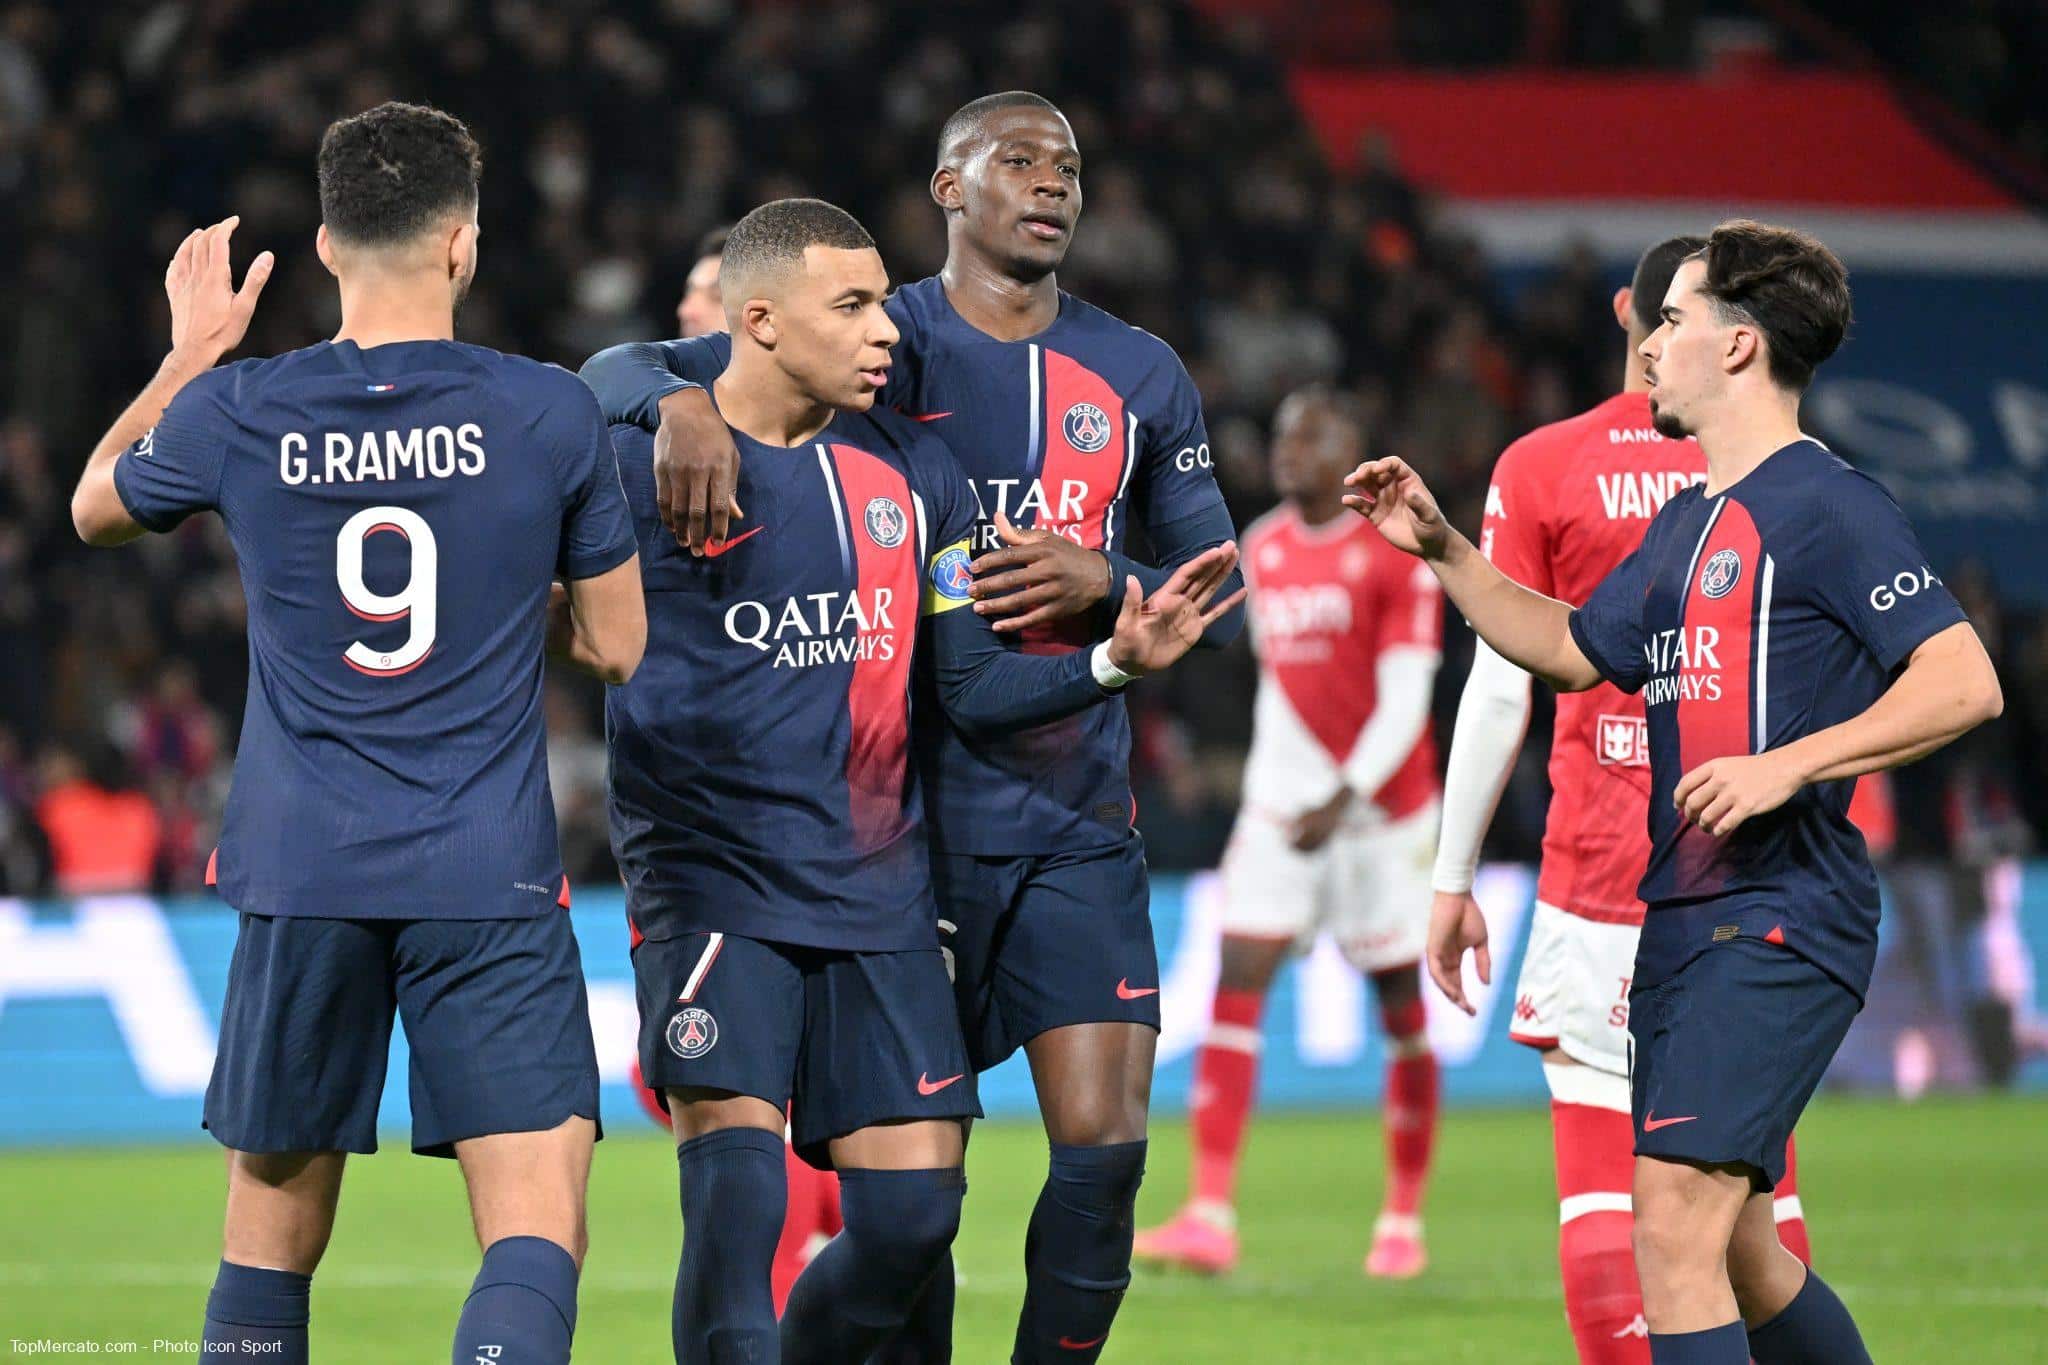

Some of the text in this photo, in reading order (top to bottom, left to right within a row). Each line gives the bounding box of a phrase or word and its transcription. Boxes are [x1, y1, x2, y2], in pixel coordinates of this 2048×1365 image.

[280, 423, 486, 485] G.RAMOS
[1175, 443, 1214, 472] GO
[1597, 472, 1707, 519] VAND
[336, 505, 438, 677] 9
[724, 587, 894, 651] QATAR
[772, 634, 894, 669] AIRWAYS
[675, 1011, 709, 1025] PARIS
